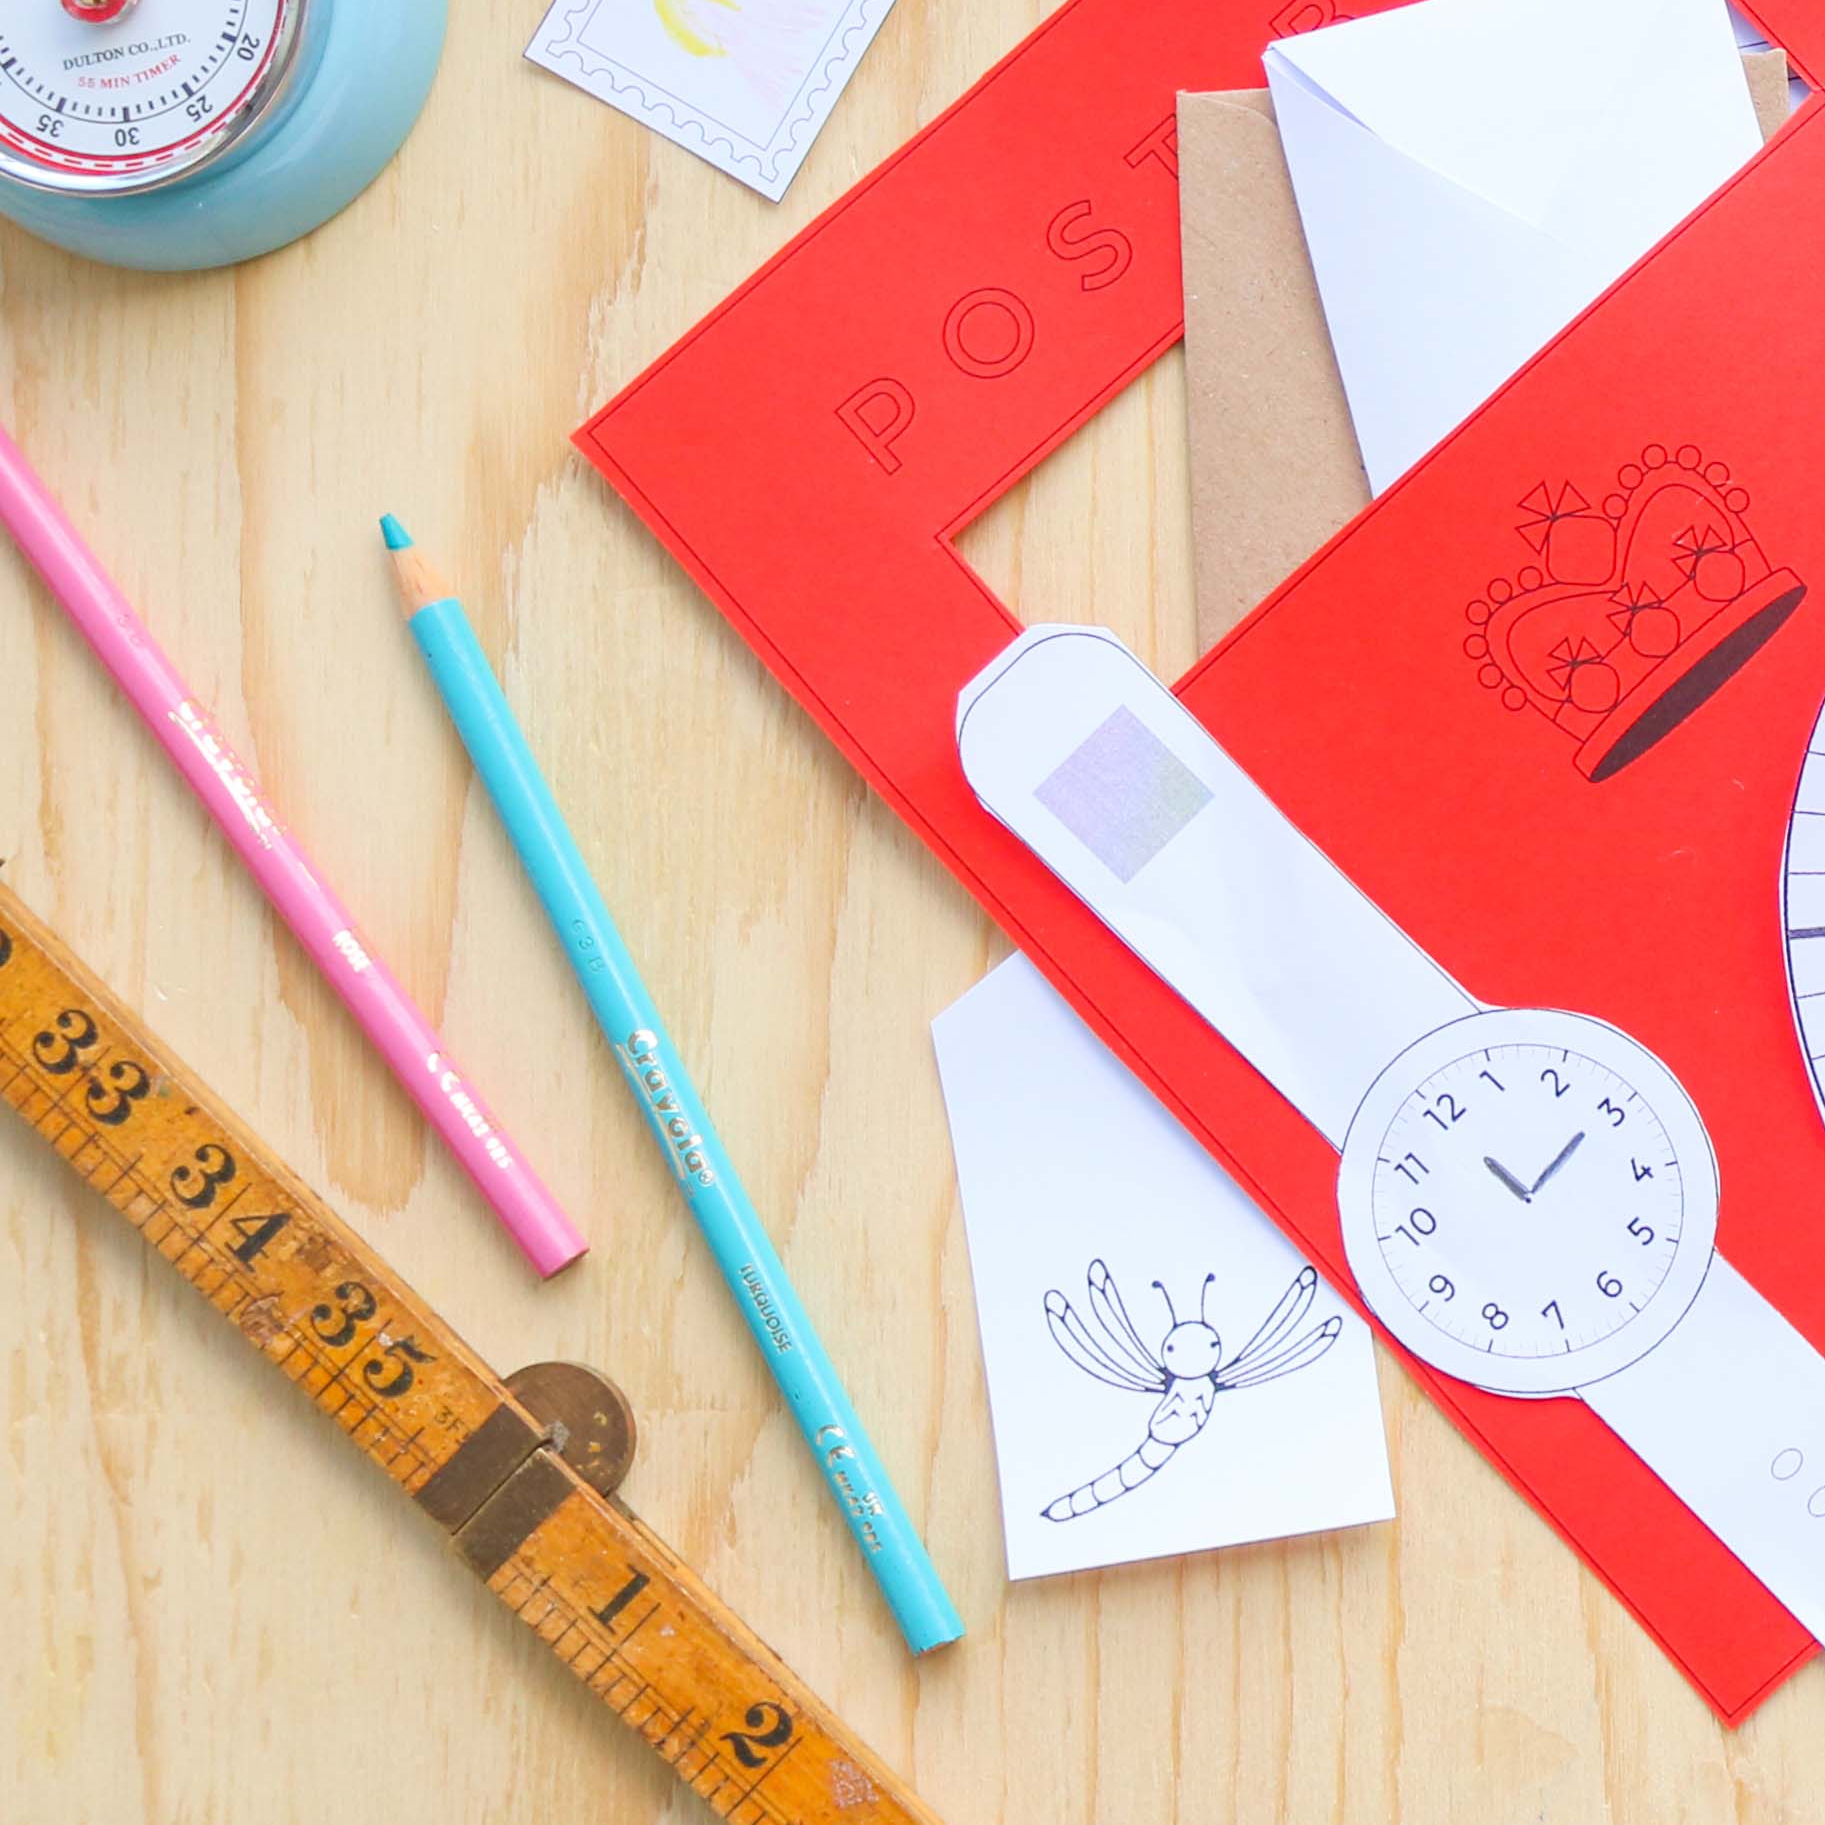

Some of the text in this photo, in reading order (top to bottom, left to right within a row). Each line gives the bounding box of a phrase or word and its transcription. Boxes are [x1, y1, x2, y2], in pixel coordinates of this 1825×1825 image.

[63, 47, 126, 71] DULTON
[237, 32, 261, 62] 20
[77, 54, 182, 89] 55 MIN TIMER
[185, 94, 214, 123] 25
[36, 113, 65, 139] 35
[115, 126, 141, 148] 30
[332, 929, 371, 972] ROSE
[33, 1008, 150, 1127] 33
[1479, 1069, 1505, 1092] 1
[1540, 1068, 1571, 1098] 2
[1422, 1093, 1467, 1131] 12
[1596, 1097, 1626, 1128] 3
[1393, 1152, 1430, 1185] 11
[1630, 1157, 1654, 1183] 4
[170, 1143, 293, 1274] 34
[1394, 1207, 1437, 1247] 10
[1626, 1216, 1655, 1246] 5
[1428, 1274, 1456, 1303] 9
[1596, 1270, 1623, 1298] 6
[739, 1262, 793, 1354] TURQUOISE
[1481, 1302, 1510, 1331] 8
[1540, 1299, 1565, 1330] 7
[309, 1280, 436, 1399] 35
[588, 1561, 651, 1632] 1
[720, 1700, 794, 1768] 2
